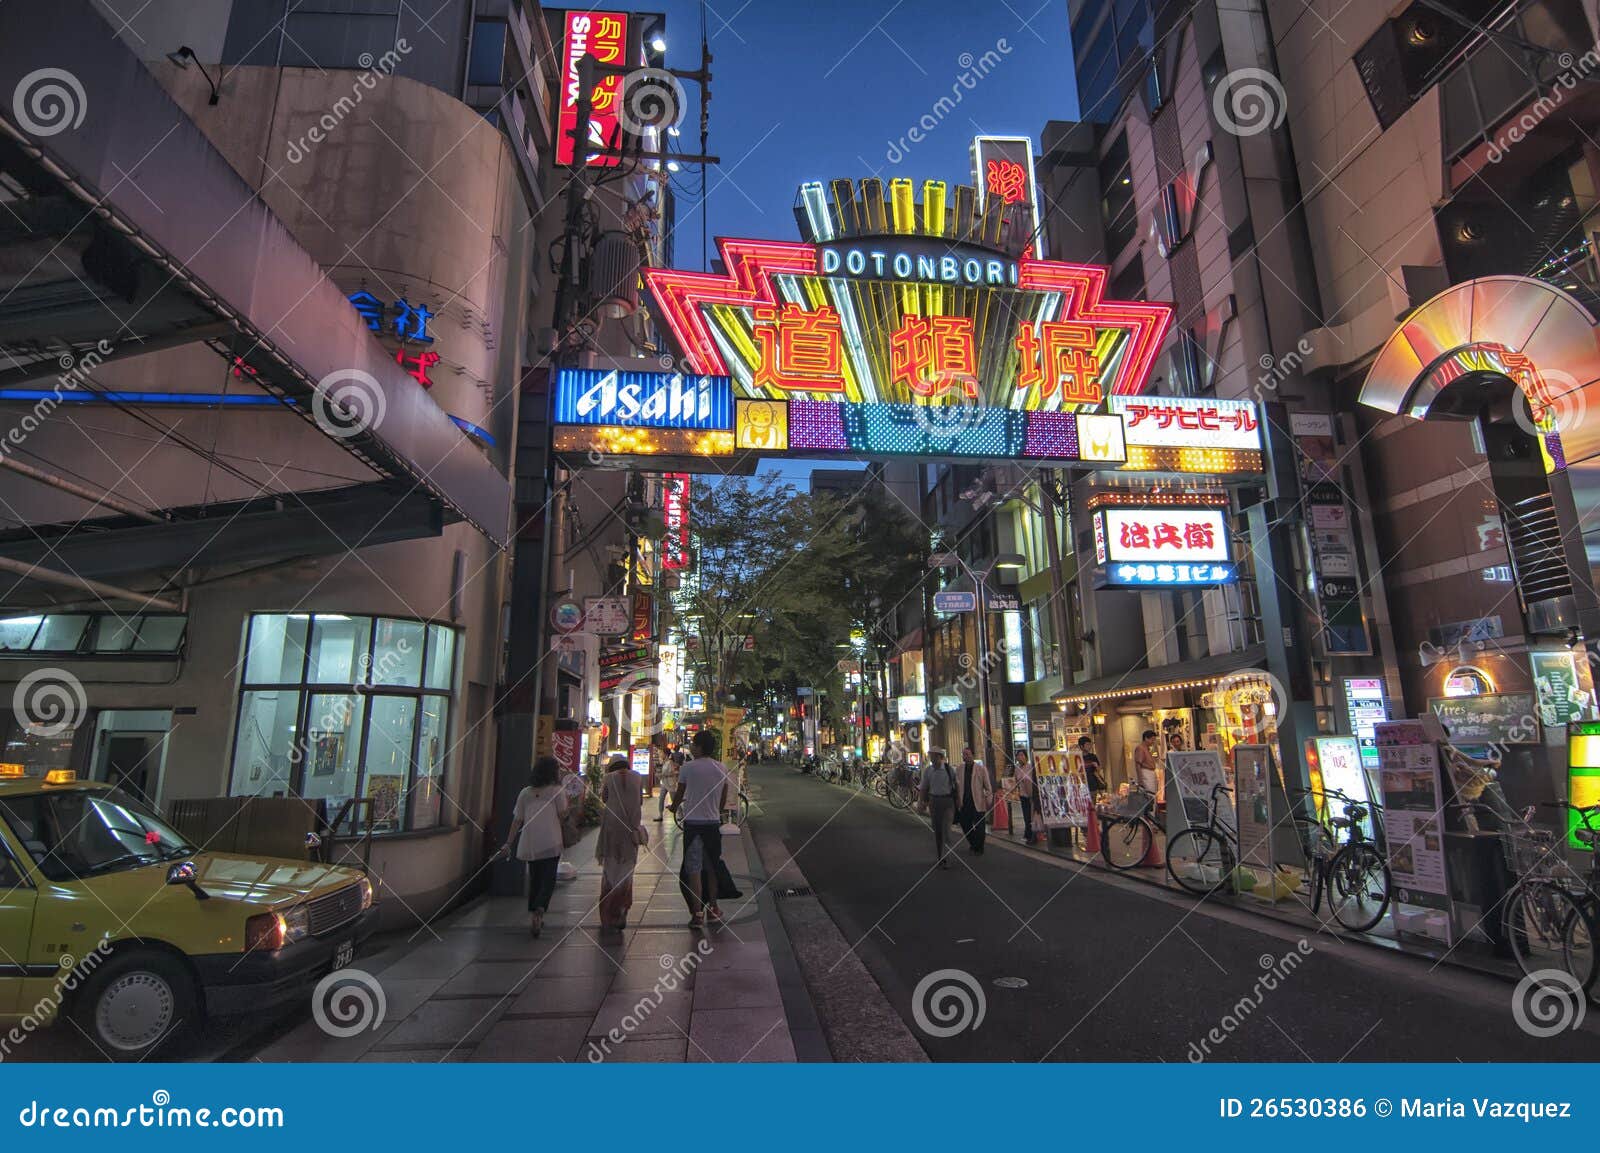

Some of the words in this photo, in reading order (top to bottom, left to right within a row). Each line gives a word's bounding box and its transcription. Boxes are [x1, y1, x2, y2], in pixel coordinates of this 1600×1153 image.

[823, 248, 1018, 285] DOTONBORI
[752, 303, 1102, 404] 道頓堀
[576, 369, 710, 421] Asahi
[1126, 404, 1259, 432] アサヒビール
[1120, 522, 1215, 550] 治兵衛
